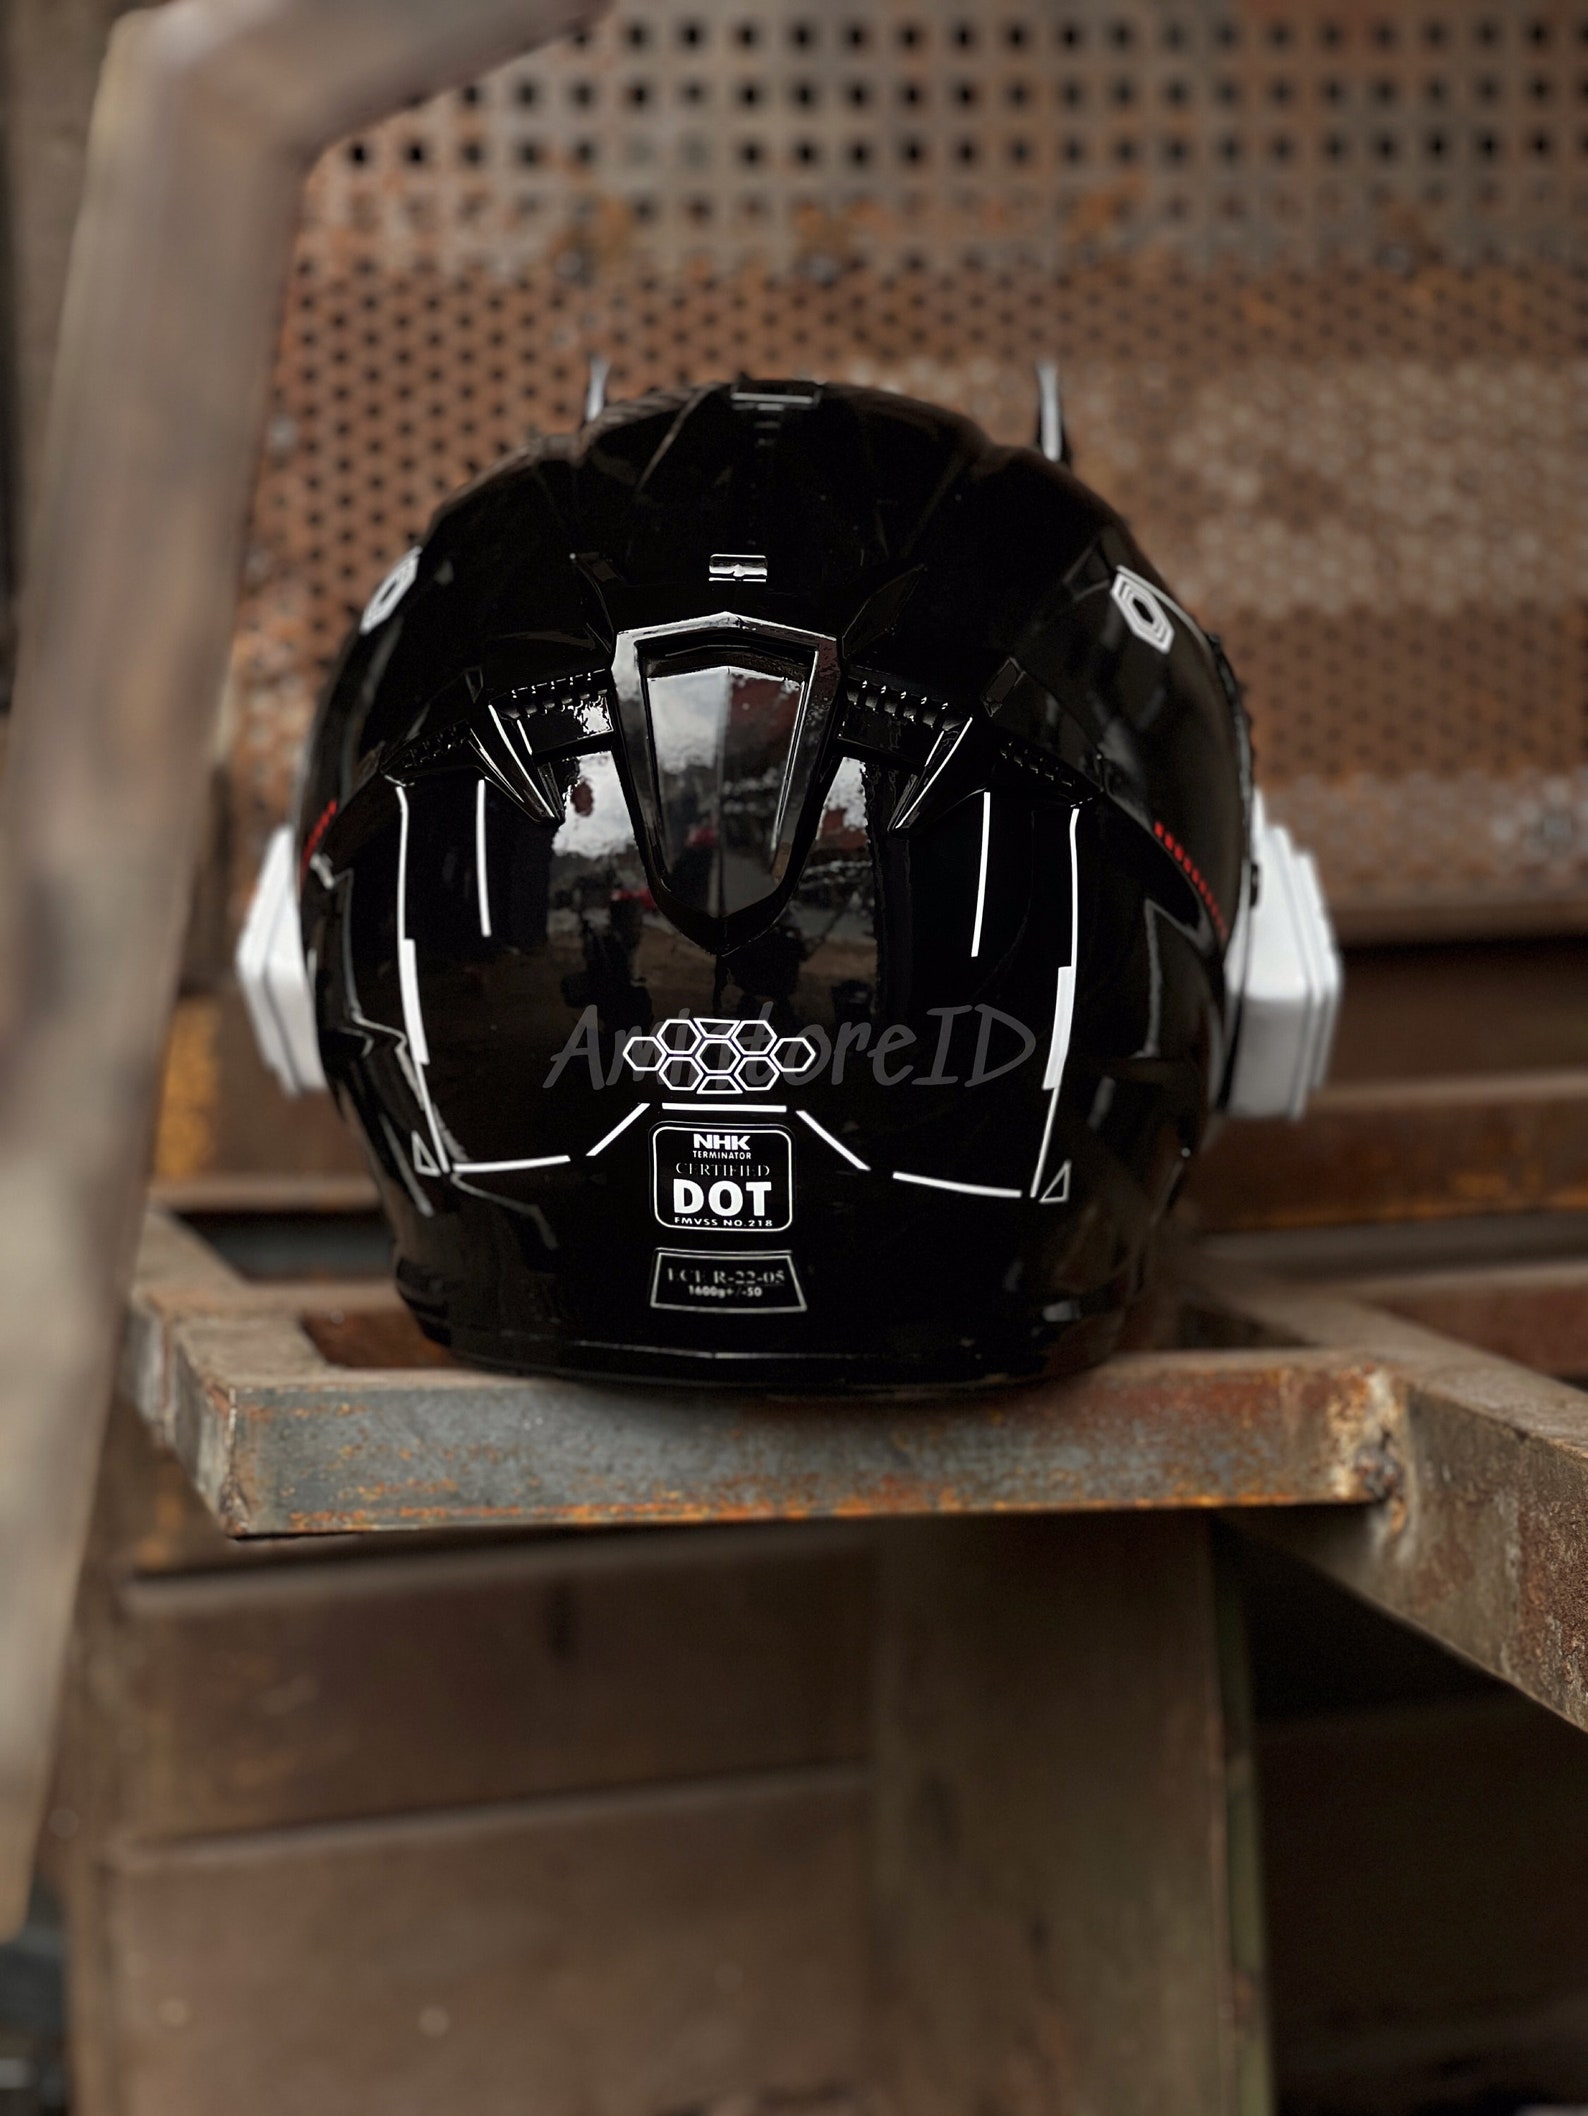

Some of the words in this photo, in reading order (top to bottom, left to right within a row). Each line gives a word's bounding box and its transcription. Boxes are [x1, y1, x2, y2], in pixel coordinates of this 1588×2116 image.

[692, 1133, 751, 1151] NHK
[692, 1150, 752, 1160] TERMINATOR
[673, 1178, 772, 1217] DOT
[674, 1216, 718, 1226] FMVSS
[723, 1219, 773, 1228] NO.218
